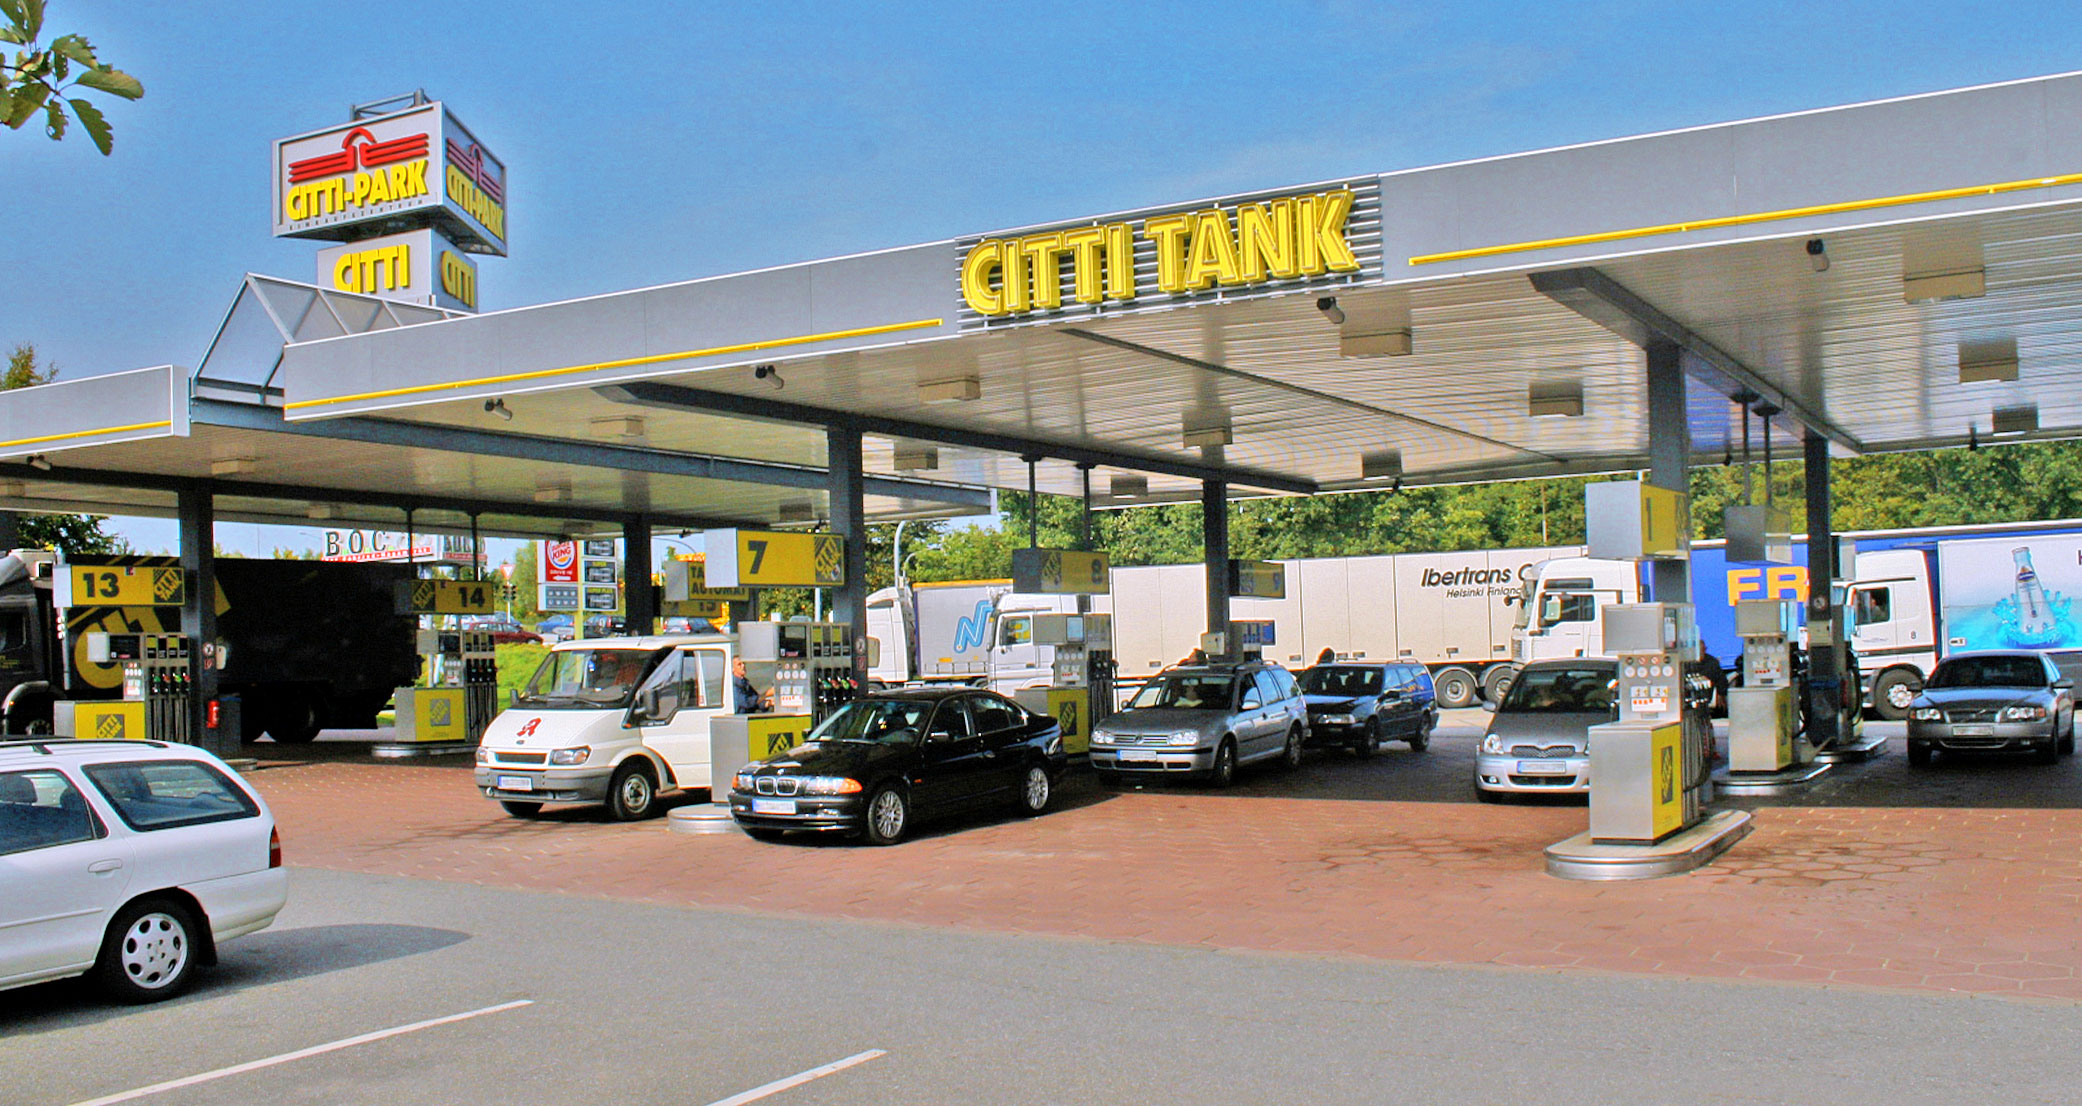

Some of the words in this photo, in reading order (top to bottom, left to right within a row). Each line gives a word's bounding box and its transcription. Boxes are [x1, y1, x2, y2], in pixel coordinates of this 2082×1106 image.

[286, 159, 429, 221] CITTI-PARK
[446, 164, 504, 241] CITTI-PARK
[333, 244, 410, 294] CITTI
[961, 222, 1135, 316] CITTI
[1143, 188, 1360, 294] TANK
[441, 250, 475, 309] CITTI
[747, 540, 769, 575] 7
[1091, 559, 1103, 585] 8
[82, 572, 120, 598] 13
[1421, 566, 1512, 588] Ibertrans
[1446, 588, 1484, 599] Helsinki
[458, 586, 486, 608] 14
